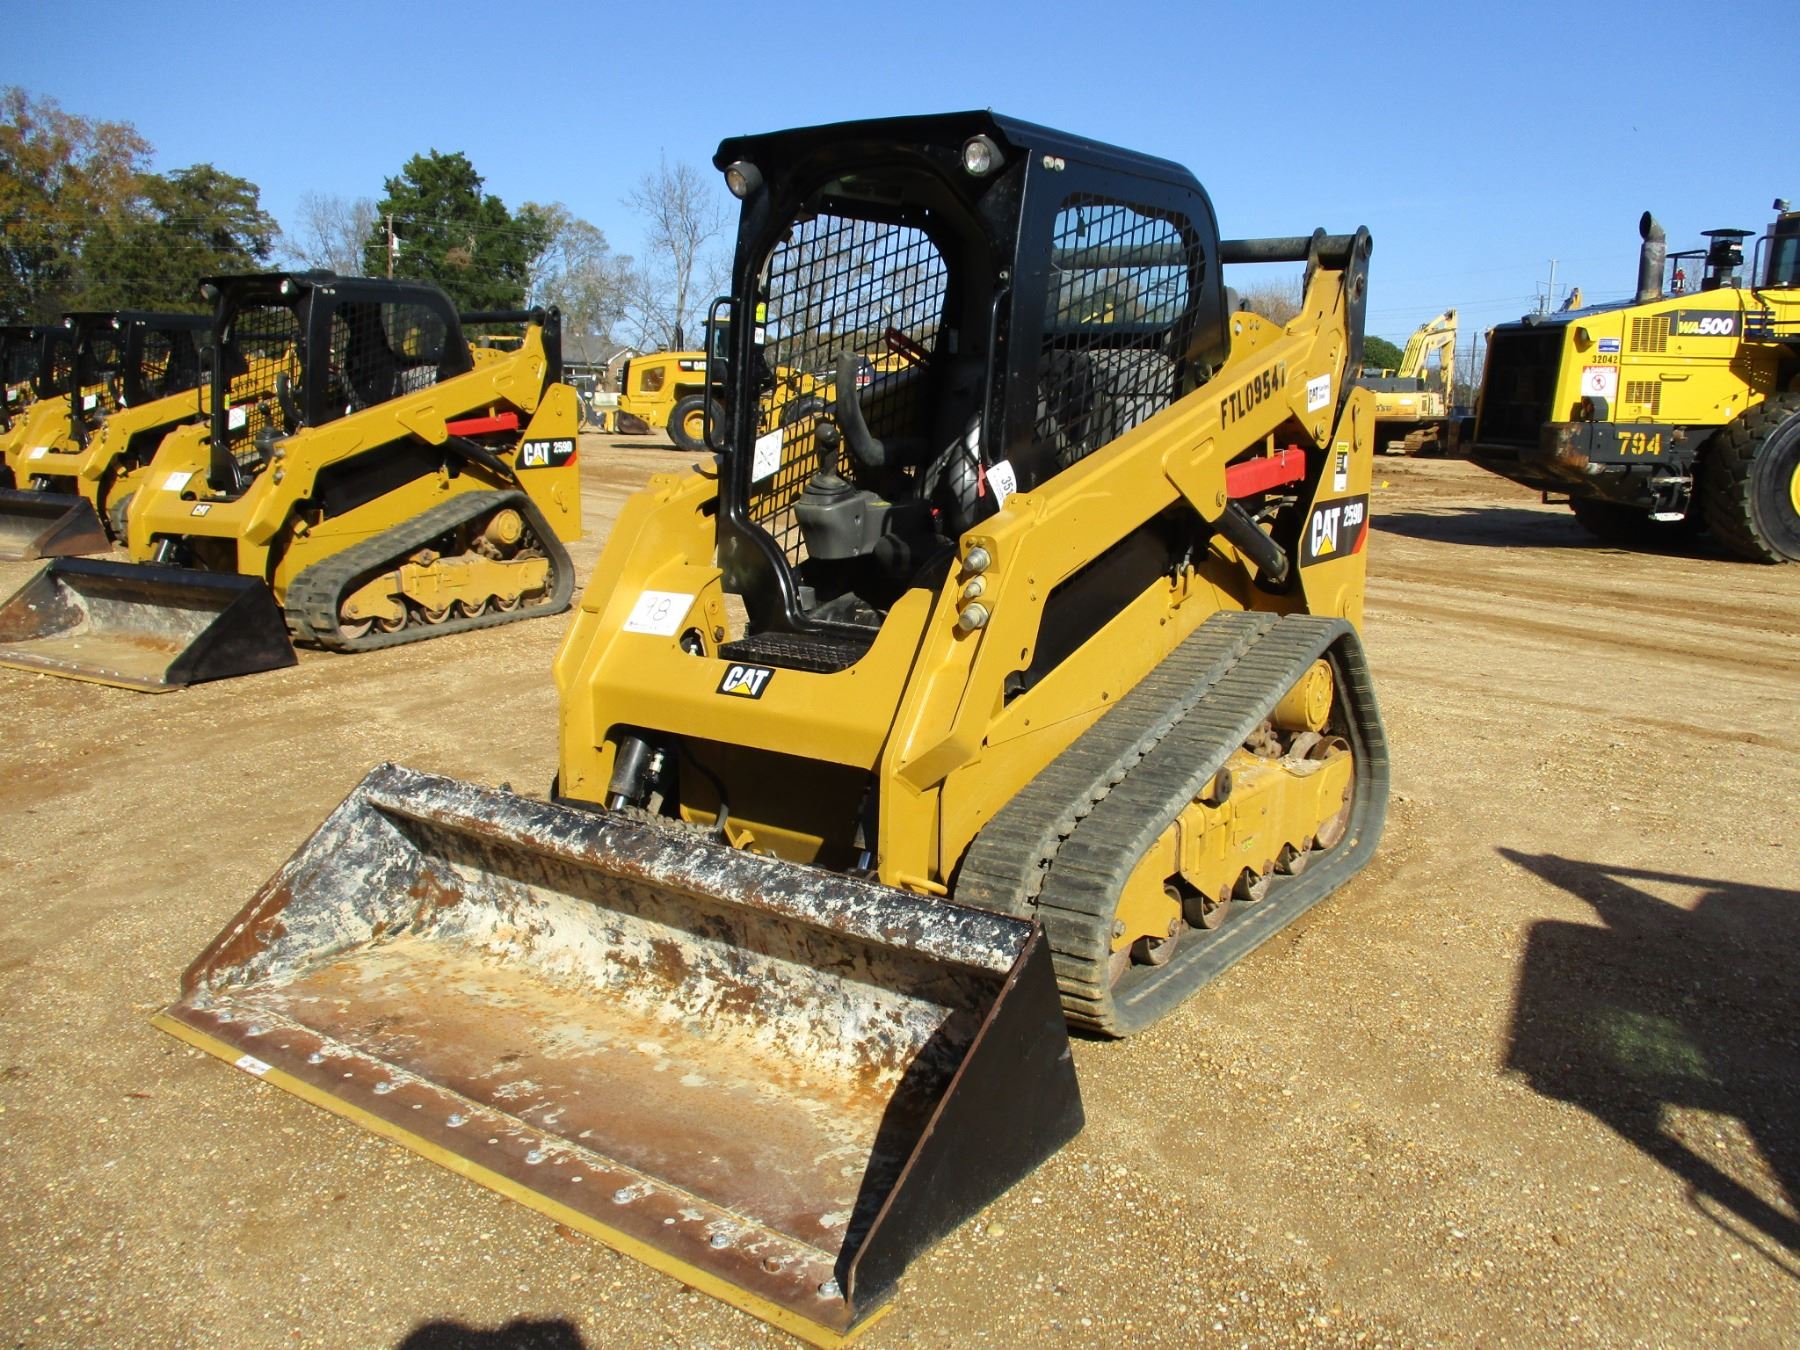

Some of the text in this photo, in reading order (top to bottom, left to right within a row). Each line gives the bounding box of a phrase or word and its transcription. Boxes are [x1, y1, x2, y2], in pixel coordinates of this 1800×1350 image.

[1679, 317, 1734, 335] WA500
[1592, 355, 1618, 364] 32042
[523, 441, 573, 466] CAT 259D
[1617, 431, 1662, 456] 794
[1311, 502, 1363, 557] CAT 259D
[722, 666, 769, 695] CAT
